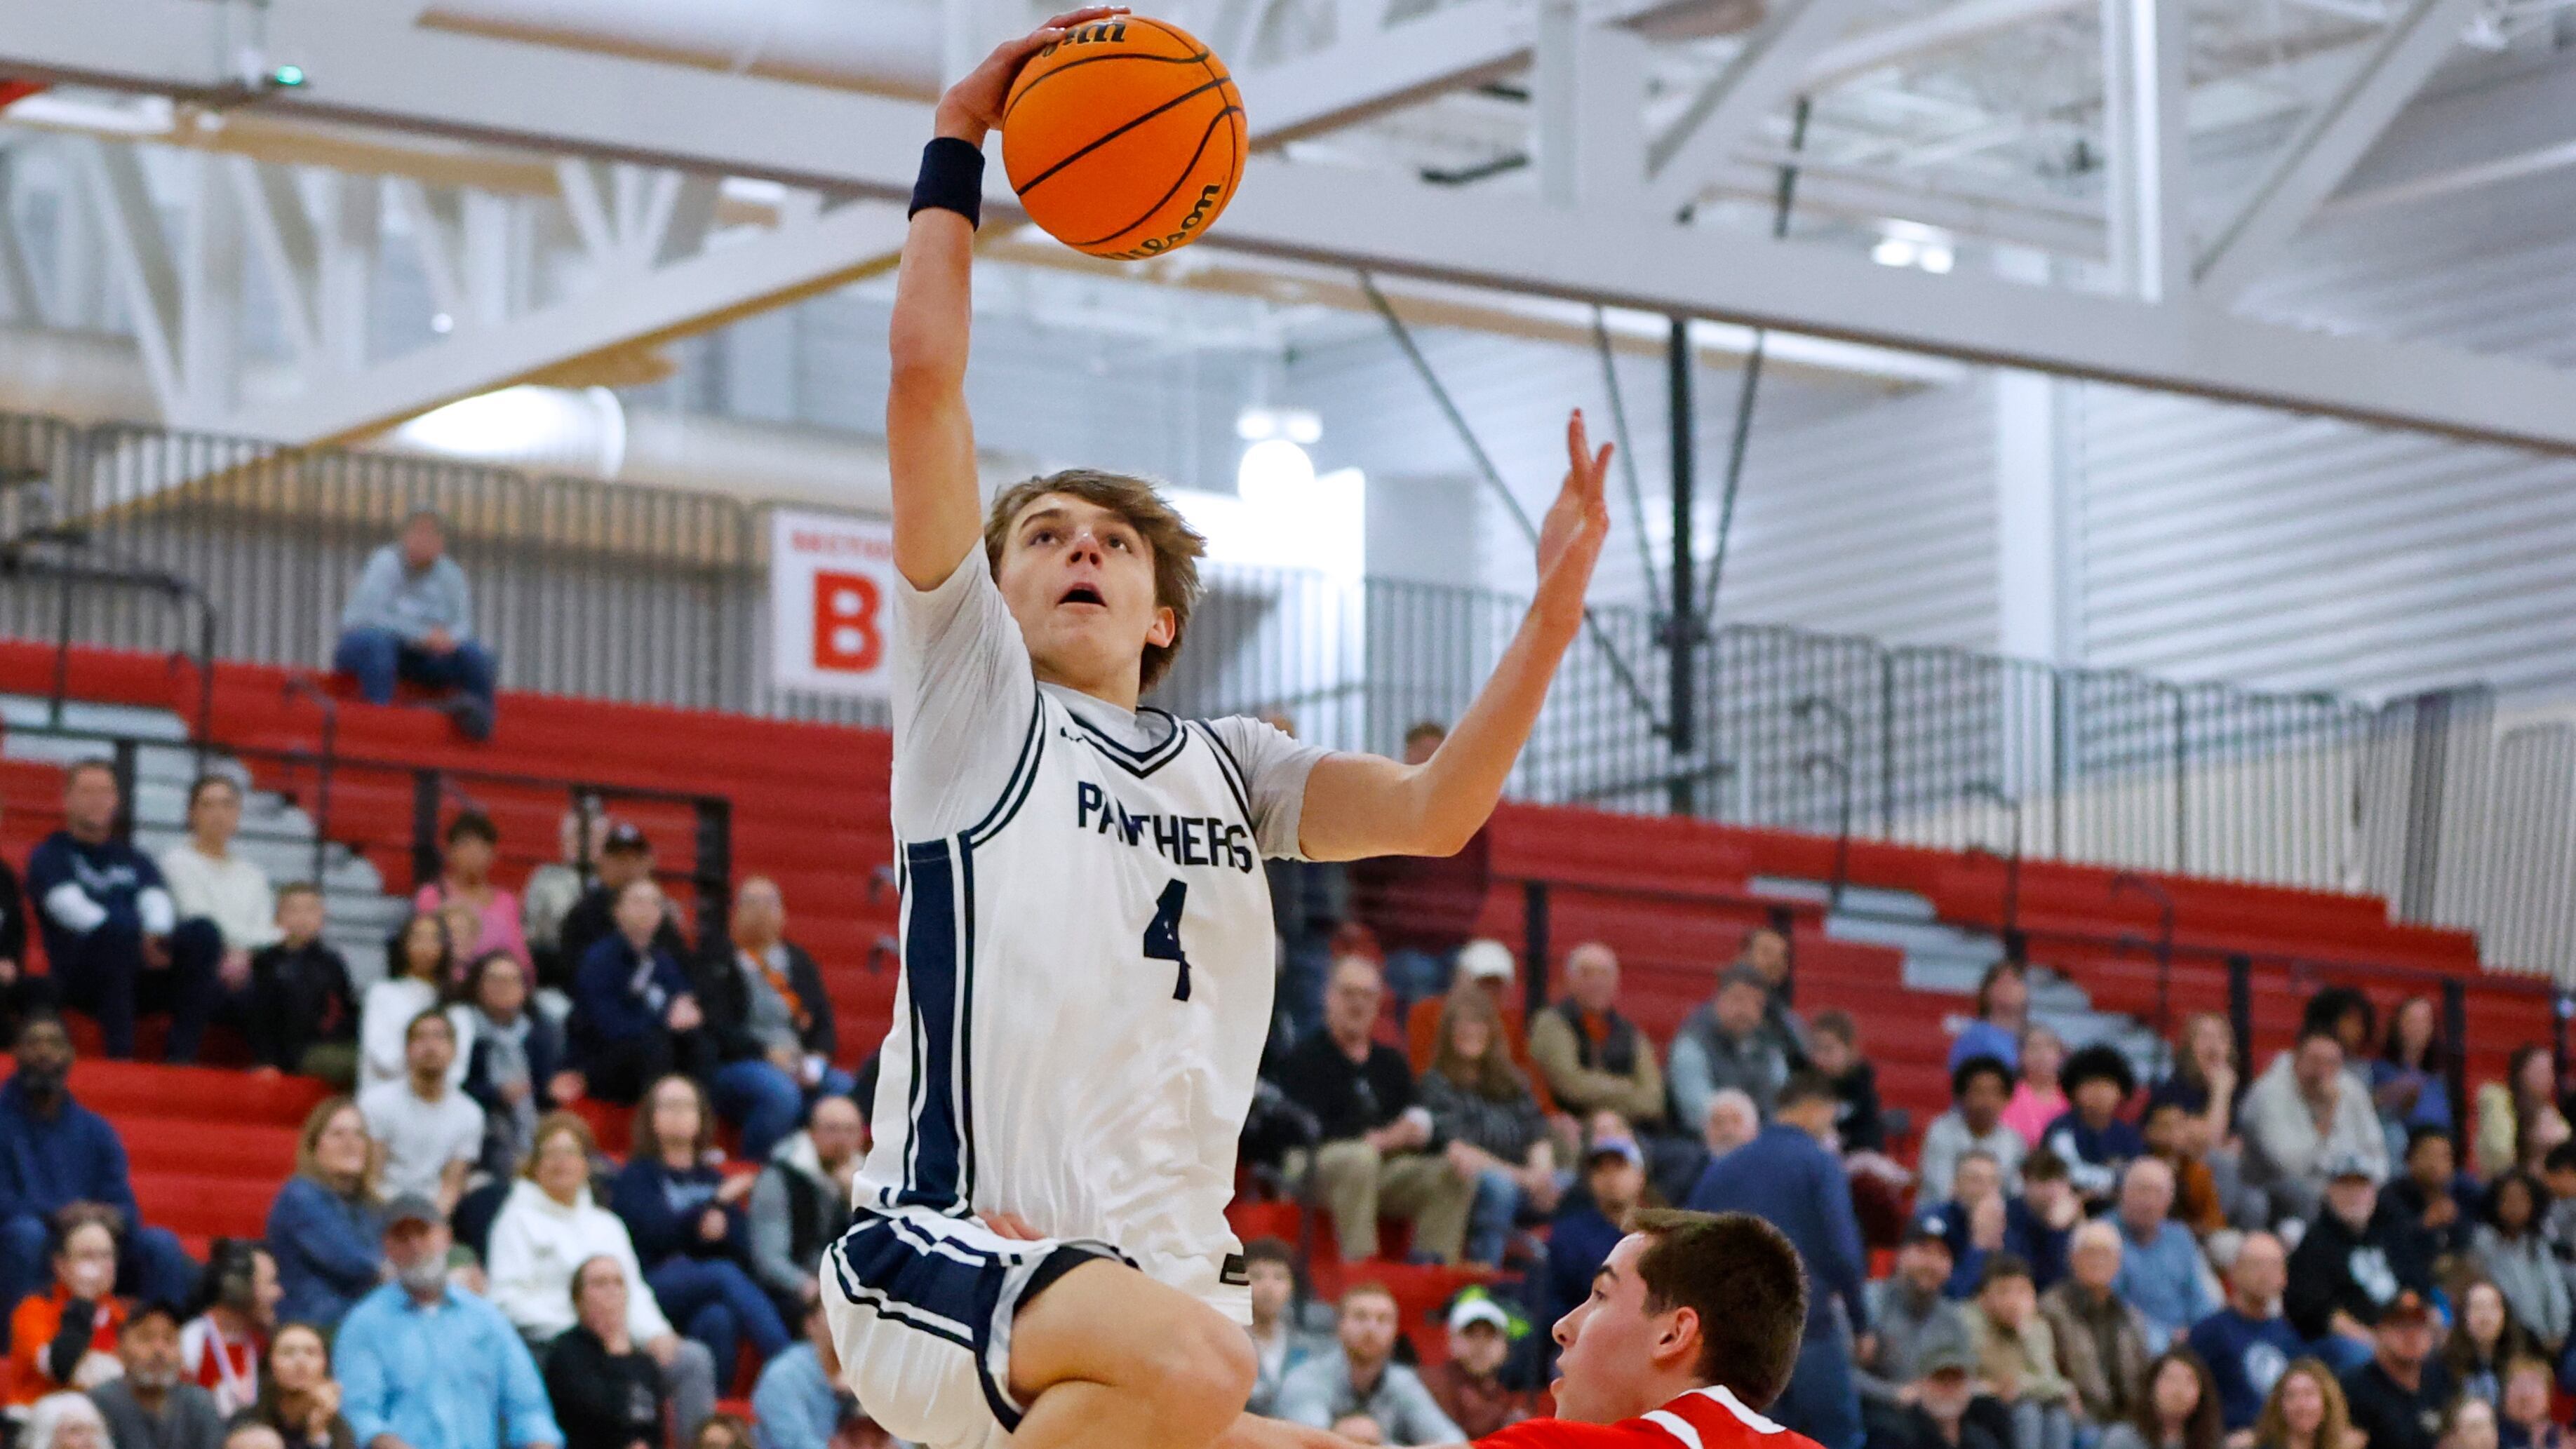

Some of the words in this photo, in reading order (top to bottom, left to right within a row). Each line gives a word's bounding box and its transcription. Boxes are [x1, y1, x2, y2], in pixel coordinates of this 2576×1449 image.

[813, 569, 883, 674] B
[1078, 781, 1253, 874] PANTHERS
[1143, 878, 1191, 1002] 4
